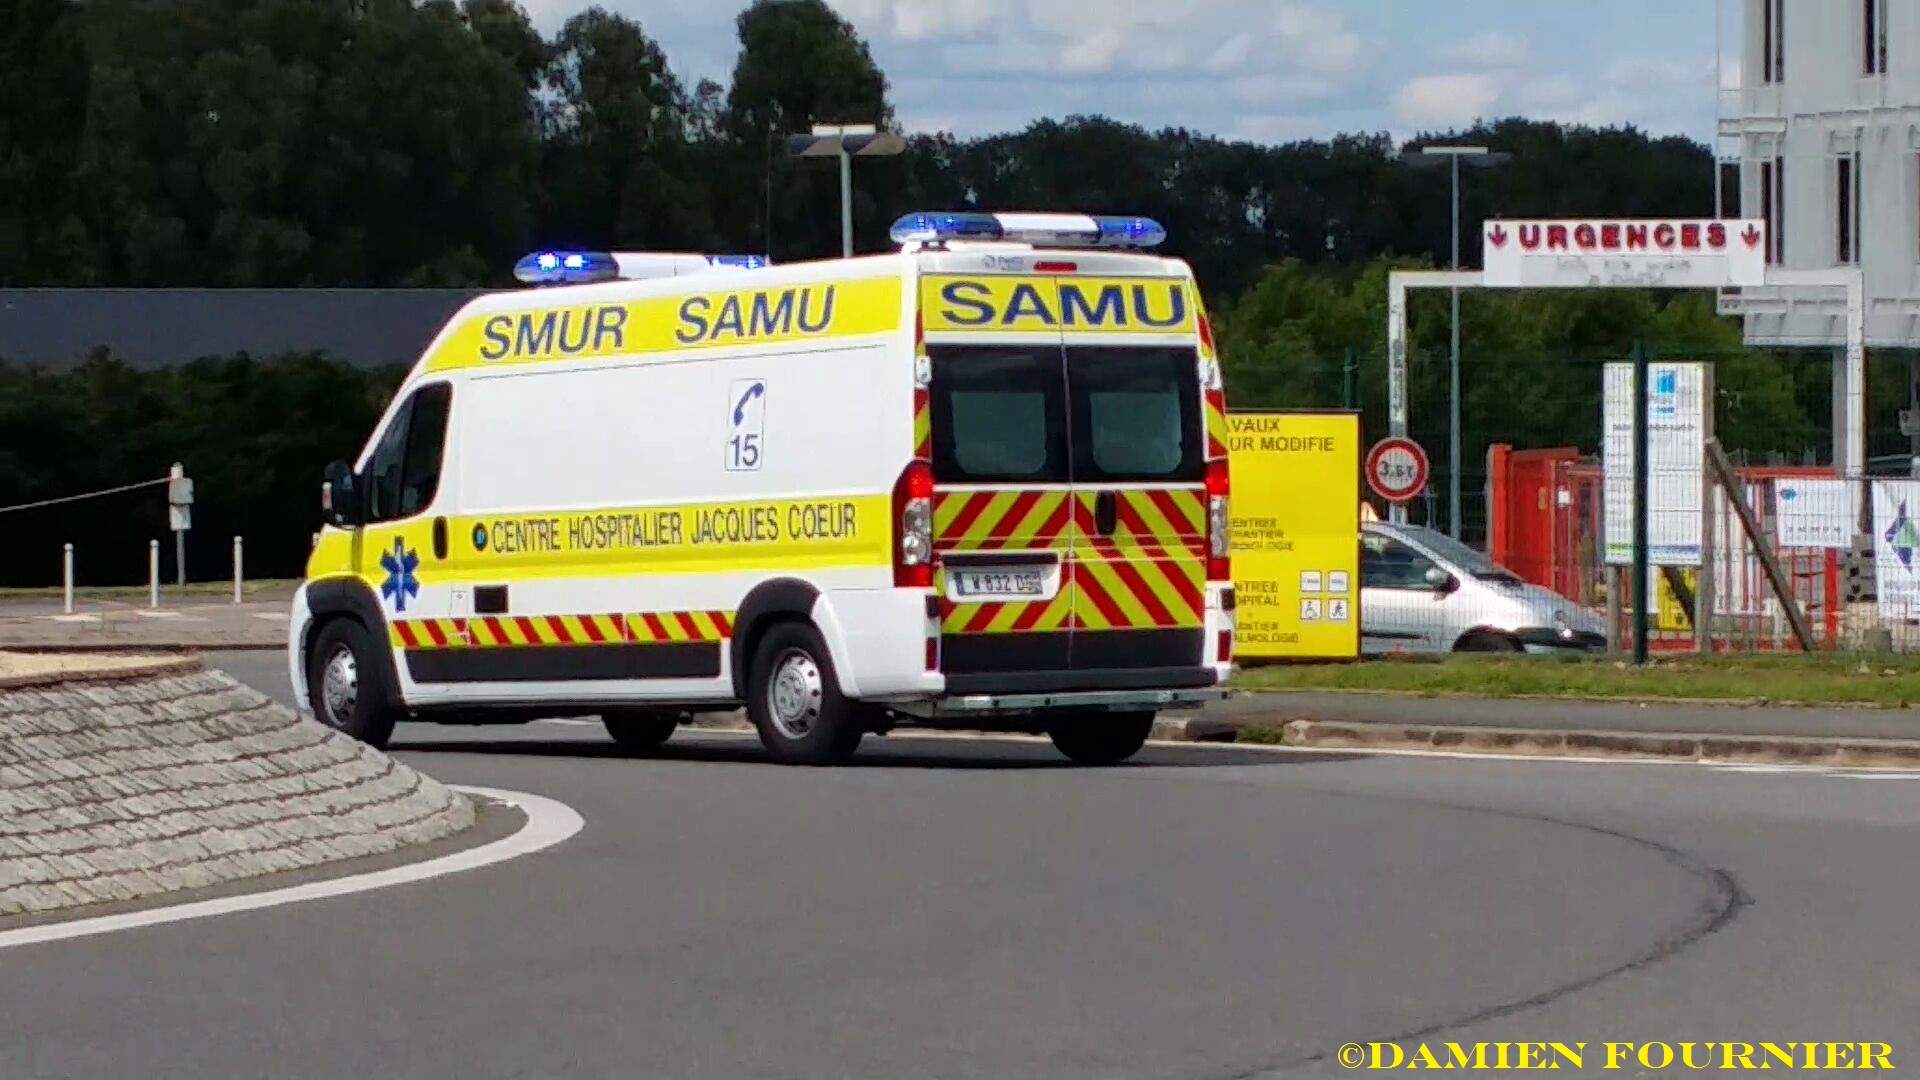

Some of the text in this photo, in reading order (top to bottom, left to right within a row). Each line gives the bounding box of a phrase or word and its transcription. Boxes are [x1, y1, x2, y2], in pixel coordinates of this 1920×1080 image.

[1519, 223, 1726, 249] URGENCES
[941, 281, 1185, 326] SAMU
[480, 285, 835, 361] SMUR SAMU
[730, 433, 759, 468] 15
[1260, 436, 1334, 451] MODIFIE
[491, 514, 561, 553] CENTRE
[569, 511, 682, 549] HOSPITALIER
[691, 506, 779, 544] JACQUES
[985, 574, 1012, 591] 832
